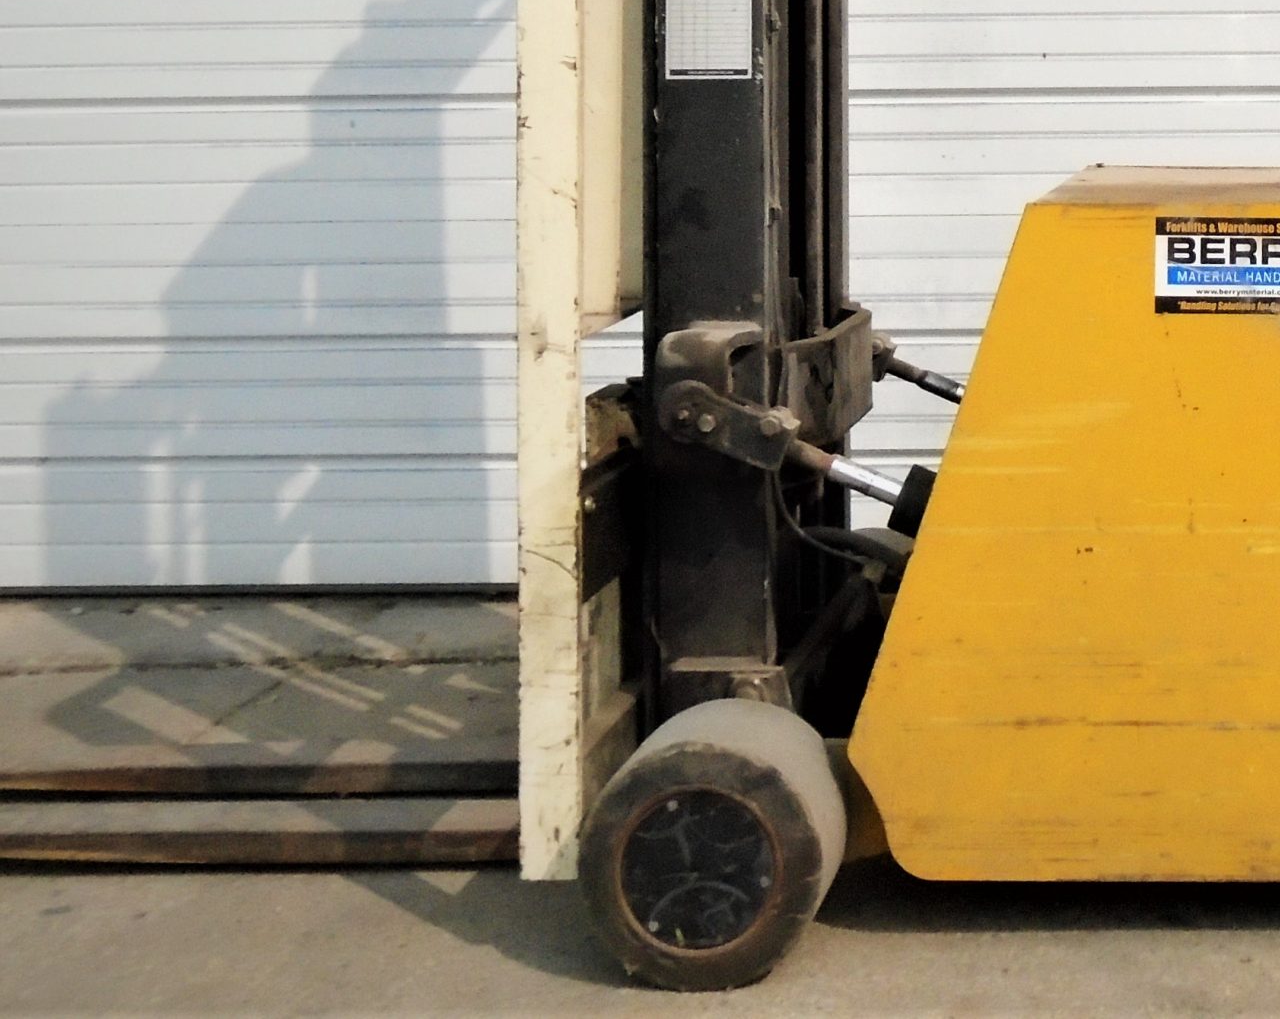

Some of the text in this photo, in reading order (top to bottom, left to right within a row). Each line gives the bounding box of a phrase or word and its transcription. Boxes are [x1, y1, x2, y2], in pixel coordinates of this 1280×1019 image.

[1166, 221, 1207, 233] Forklifts
[1209, 223, 1216, 233] &
[1218, 222, 1275, 234] Warehouse
[1177, 271, 1240, 283] MATERIAL
